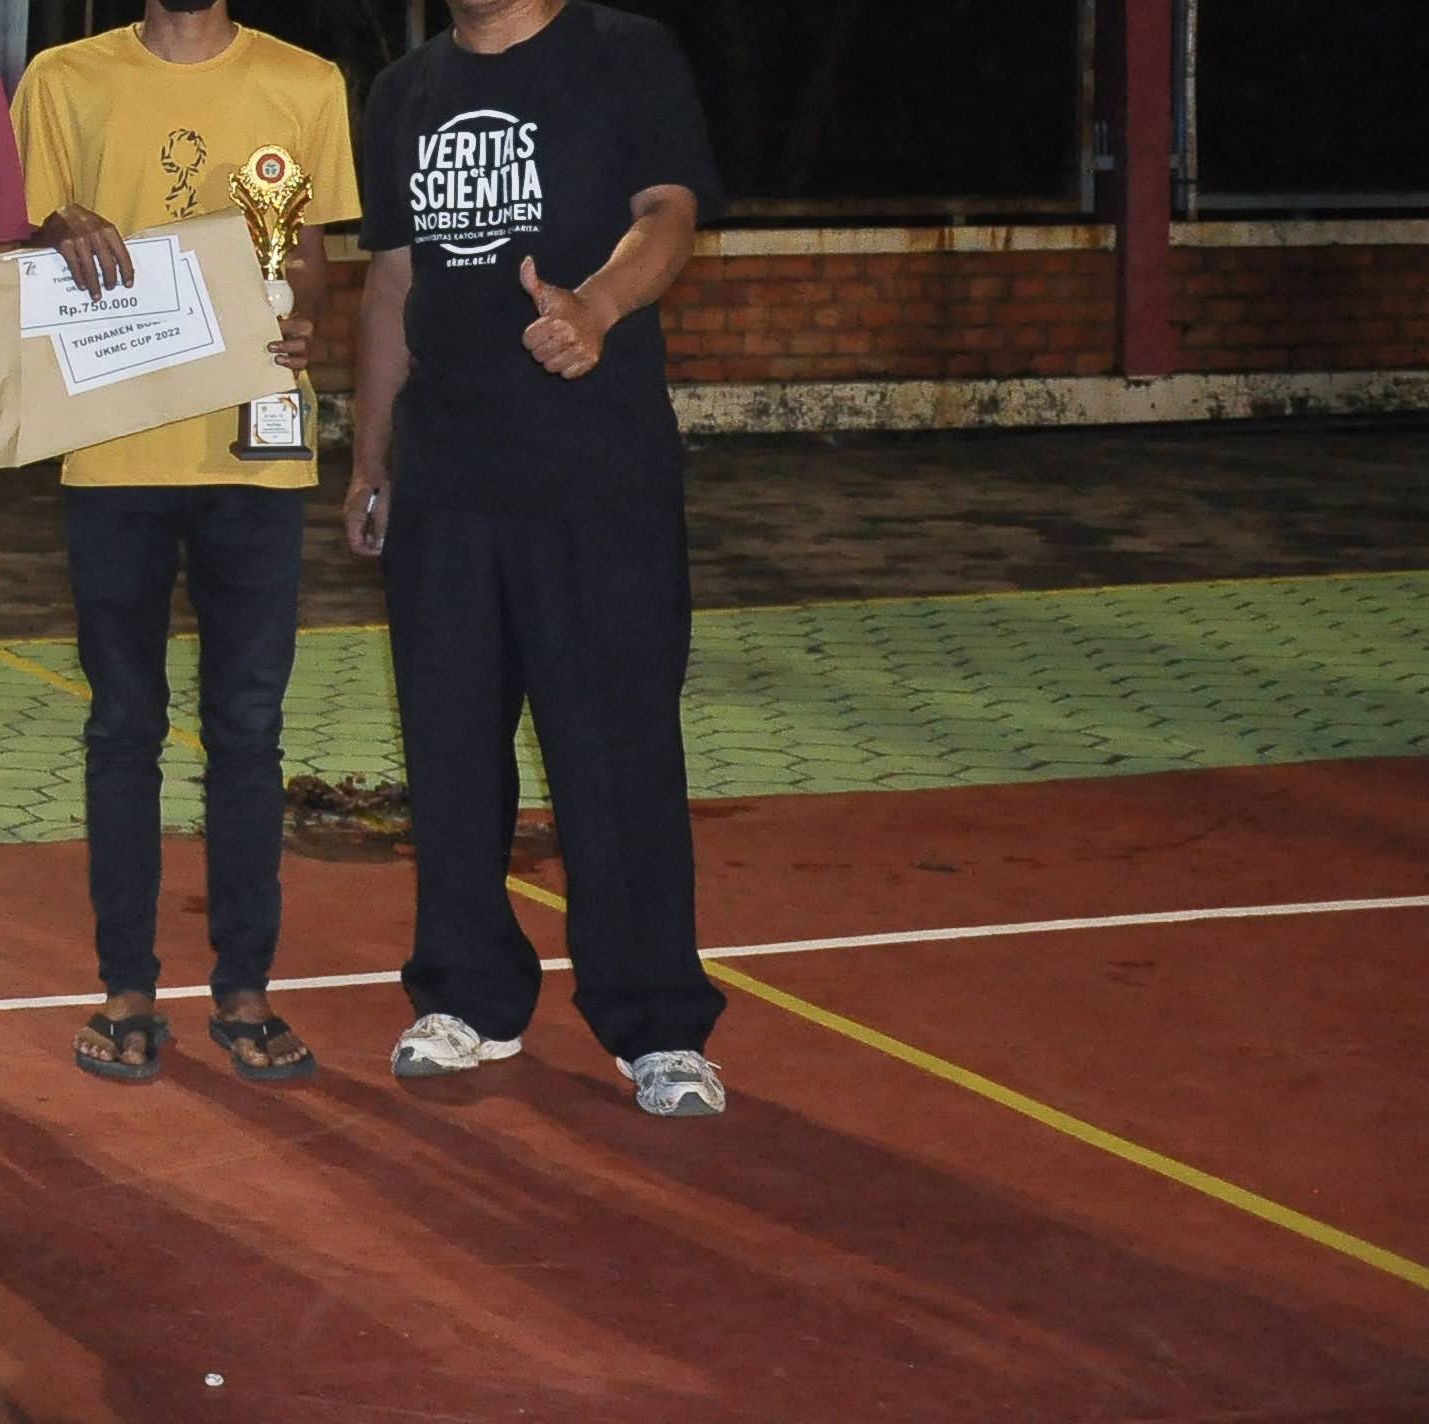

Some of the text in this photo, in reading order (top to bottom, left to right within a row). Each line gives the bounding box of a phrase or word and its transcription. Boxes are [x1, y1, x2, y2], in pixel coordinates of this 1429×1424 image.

[418, 122, 538, 171] VERITAS
[409, 159, 543, 212] SCIENTIA
[413, 202, 542, 232] NOBIS LUMEN
[59, 296, 138, 317] Rp.750.000
[71, 323, 134, 349] TURNAMEN
[94, 327, 182, 359] UKMC CUP 2022
